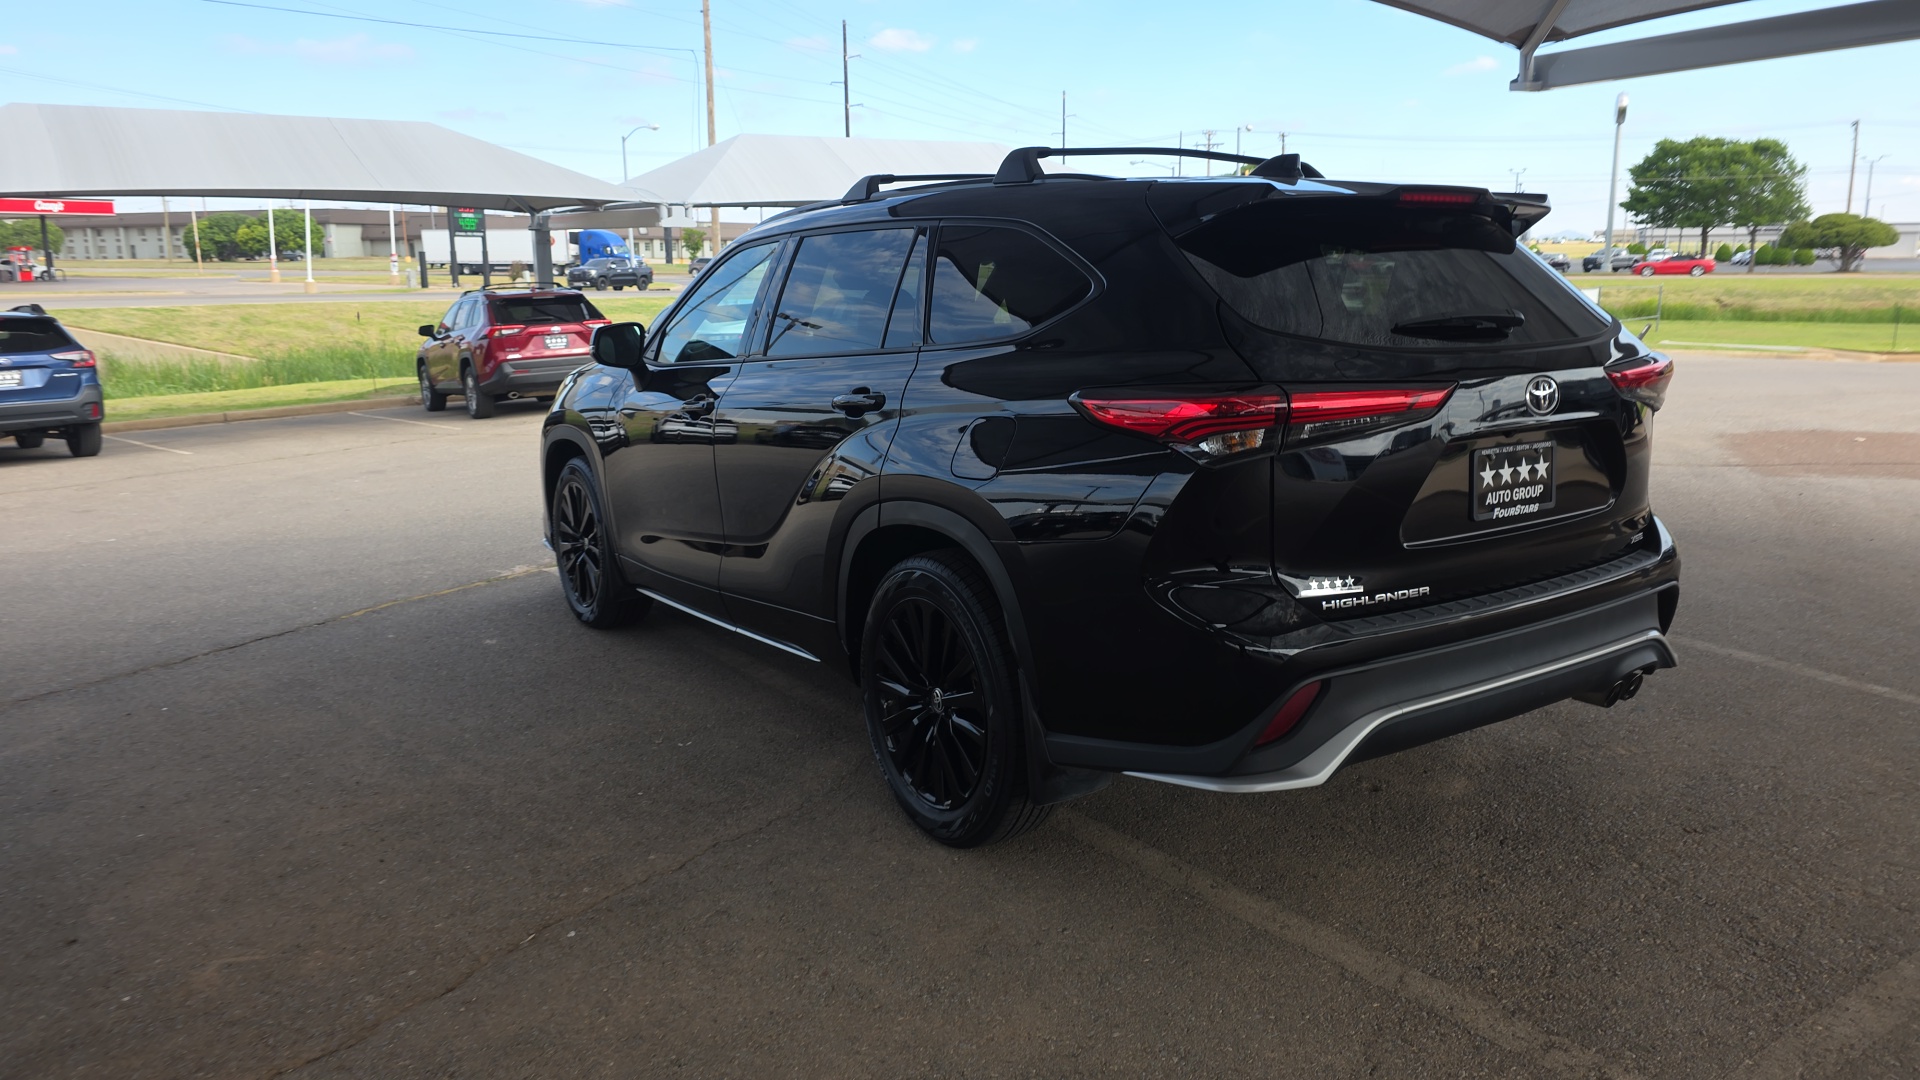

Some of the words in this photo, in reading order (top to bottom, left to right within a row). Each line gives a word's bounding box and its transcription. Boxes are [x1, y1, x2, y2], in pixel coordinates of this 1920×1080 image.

[1485, 489, 1511, 506] AUTO
[1512, 484, 1544, 501] GROUP
[1322, 586, 1430, 611] HIGHLANDER
